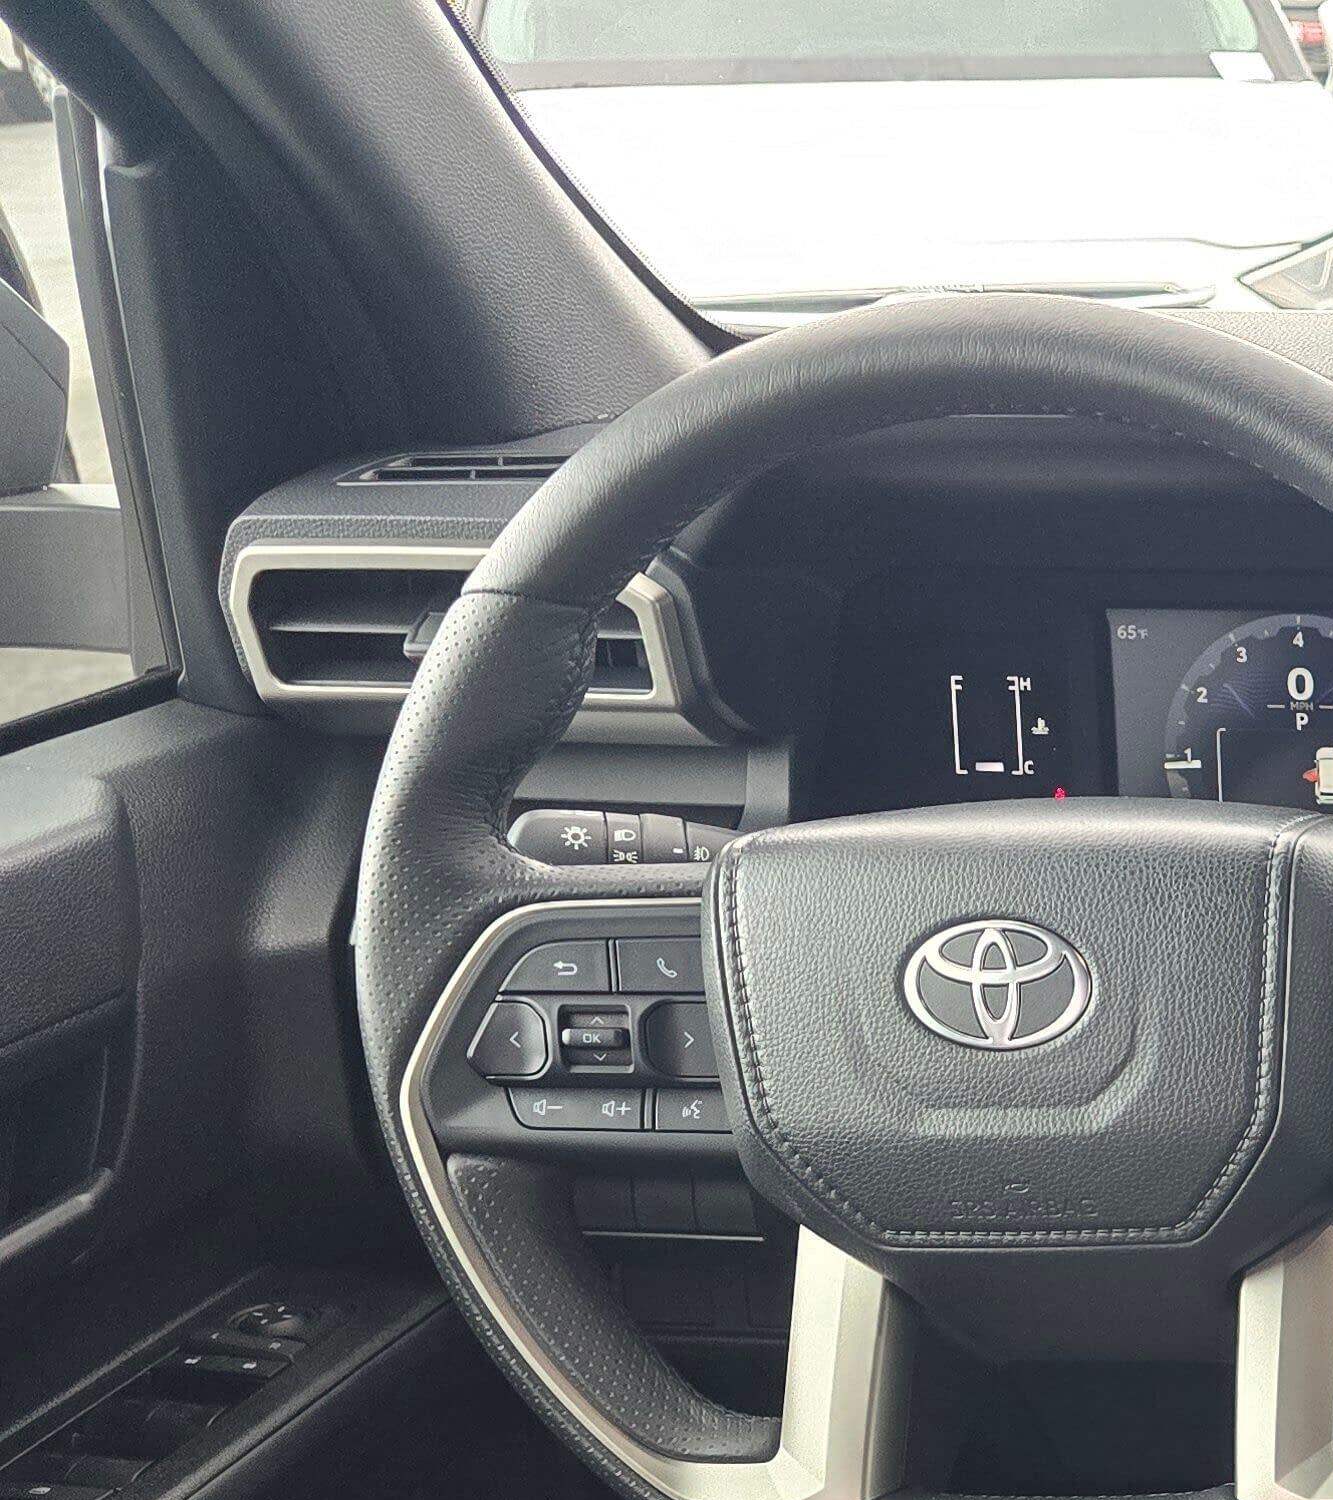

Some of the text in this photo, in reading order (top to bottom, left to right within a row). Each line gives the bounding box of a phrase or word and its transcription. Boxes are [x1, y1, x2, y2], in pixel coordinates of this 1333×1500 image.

[1292, 631, 1304, 648] 4
[1236, 646, 1248, 663] 3
[1196, 686, 1208, 704] 2
[1290, 701, 1314, 711] MPH
[1296, 713, 1309, 731] P
[582, 1033, 601, 1044] OK
